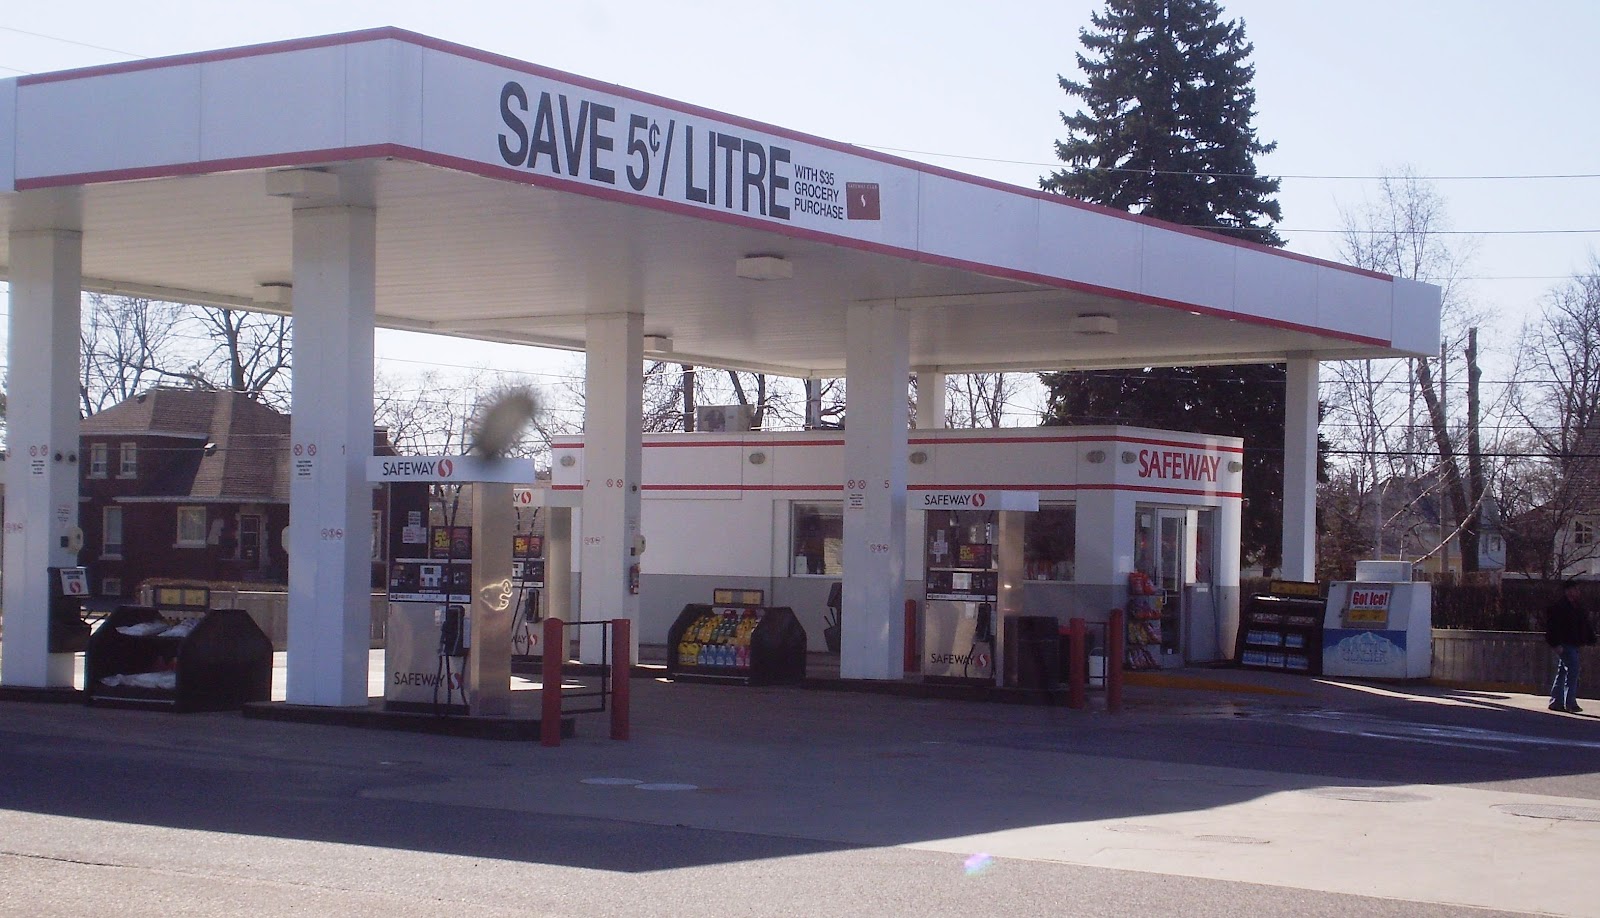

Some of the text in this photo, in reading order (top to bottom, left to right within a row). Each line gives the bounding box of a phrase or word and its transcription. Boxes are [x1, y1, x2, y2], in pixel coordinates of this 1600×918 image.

[498, 81, 615, 185] SAVE
[685, 125, 791, 221] LITRE
[794, 164, 835, 186] WITH $35
[794, 181, 839, 203] GROCERY
[794, 197, 844, 220] PURCHASE
[382, 461, 436, 476] SAFEWAY
[1138, 449, 1221, 482] SAFEWAY
[884, 480, 890, 489] 5
[924, 494, 971, 506] SAFEWAY
[1353, 591, 1368, 605] Got
[931, 653, 974, 665] SAFEWAY
[394, 671, 446, 687] SAFEWAY
